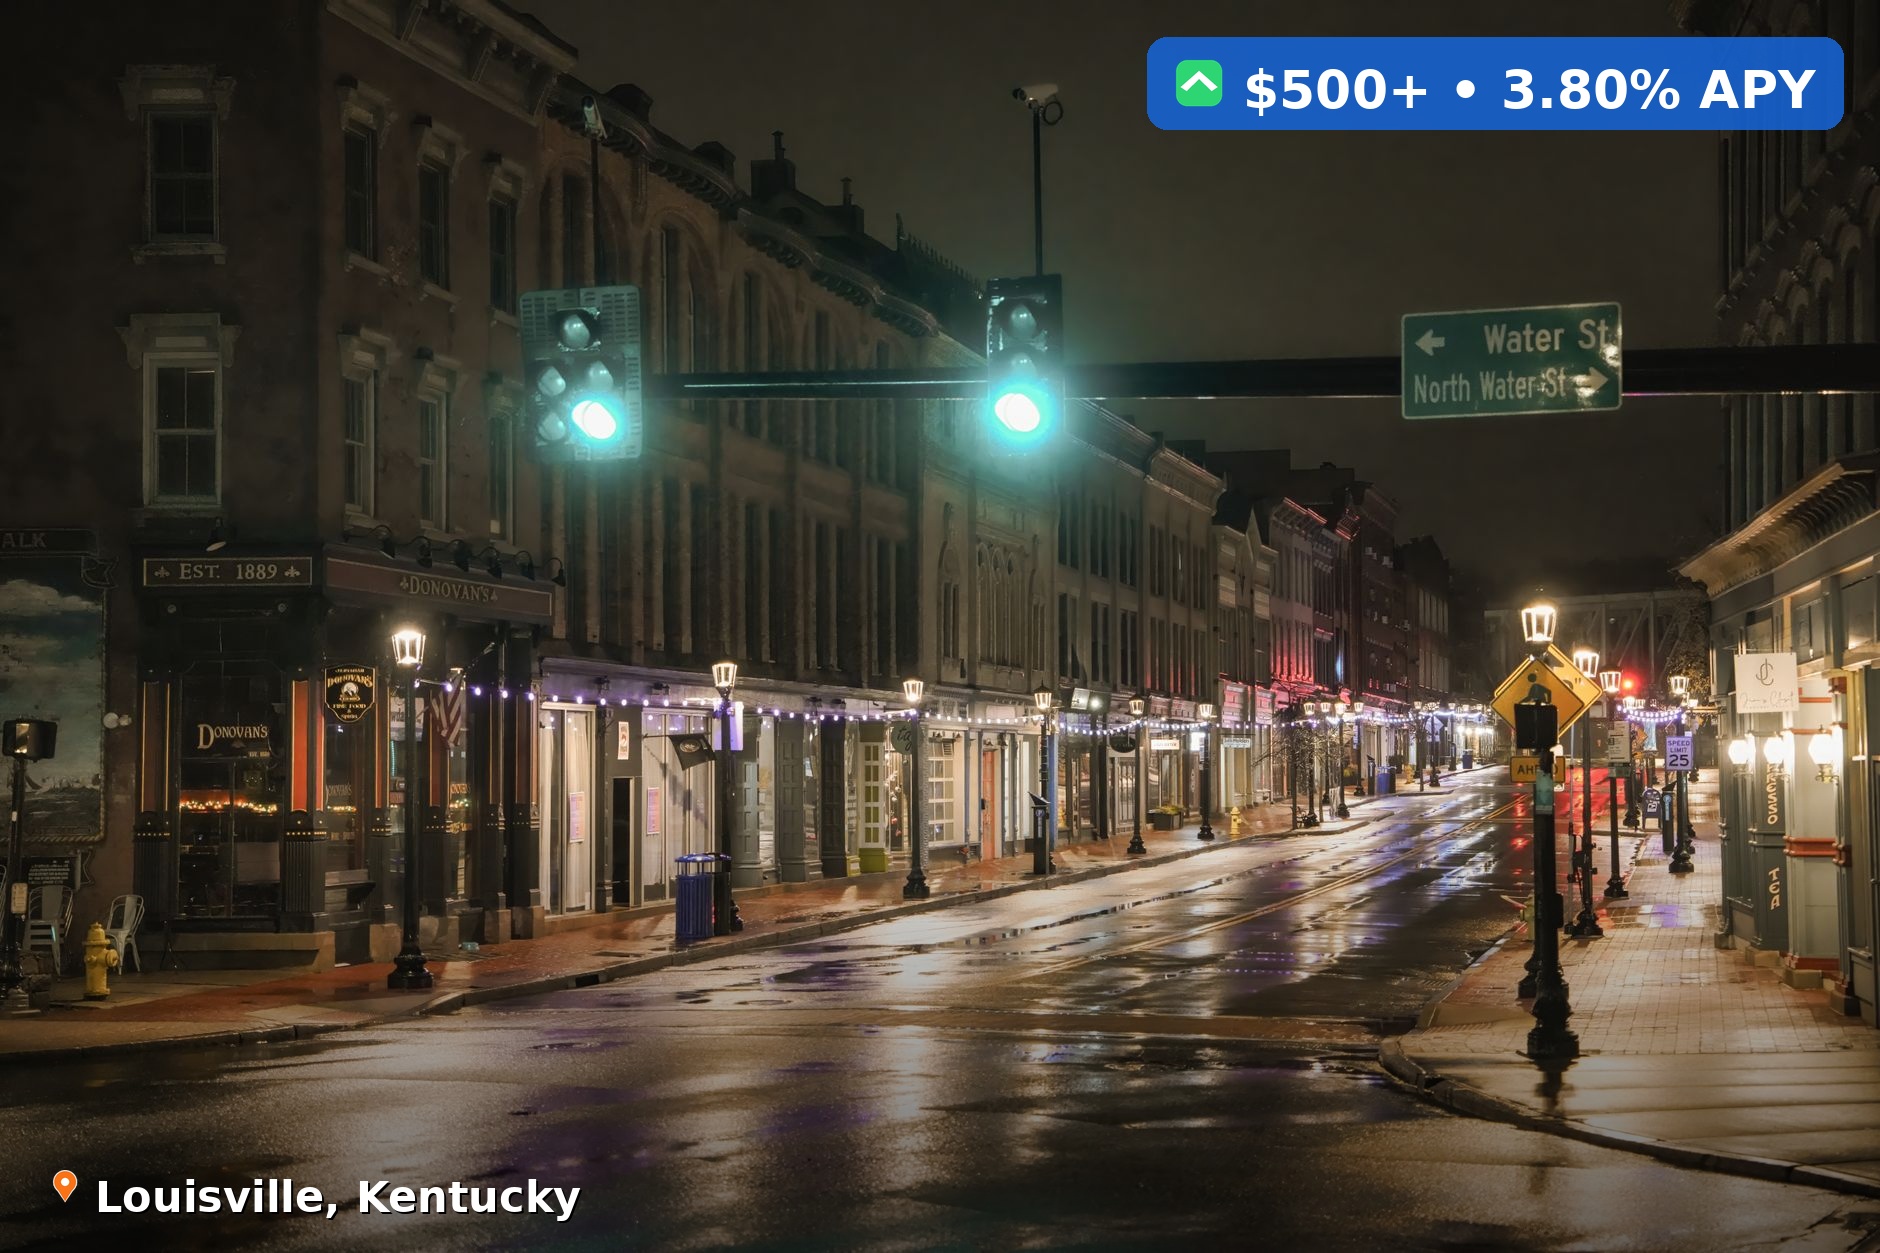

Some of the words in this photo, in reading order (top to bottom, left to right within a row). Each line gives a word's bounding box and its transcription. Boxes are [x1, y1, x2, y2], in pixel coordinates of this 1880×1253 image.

[1484, 322, 1565, 355] Water
[1577, 317, 1609, 350] St
[1413, 373, 1471, 404] North
[1479, 370, 1537, 401] Water
[1544, 366, 1567, 398] St
[0, 532, 47, 549] ALK
[178, 562, 221, 580] EST.
[236, 563, 278, 580] 1889
[409, 575, 490, 603] DONOVAN'S
[327, 674, 374, 688] DONOVAN'S
[197, 723, 268, 750] DONOVAN'S
[1517, 764, 1558, 775] AHED
[1668, 754, 1690, 767] 25
[1766, 764, 1778, 825] RESSO
[1768, 867, 1781, 911] TEA
